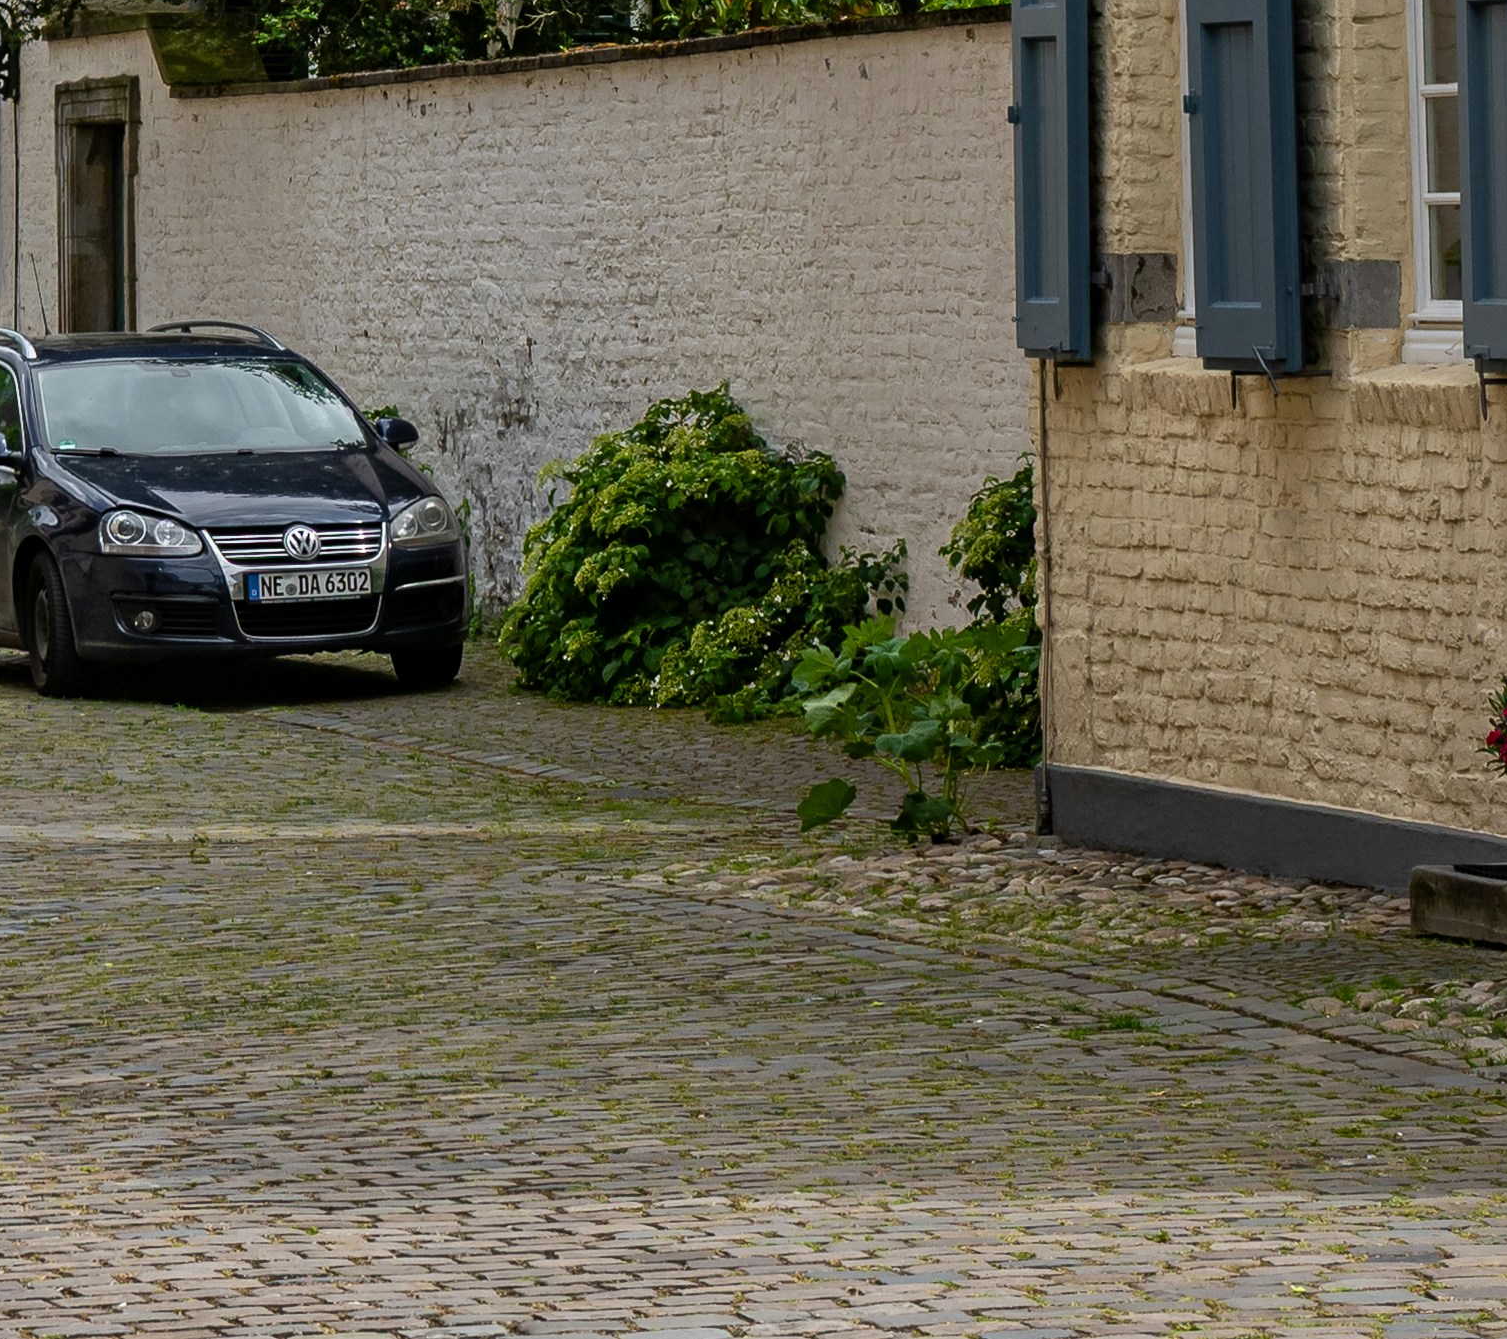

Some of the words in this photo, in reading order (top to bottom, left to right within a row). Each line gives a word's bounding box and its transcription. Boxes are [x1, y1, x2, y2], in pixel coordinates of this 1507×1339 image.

[261, 576, 284, 597] NE
[298, 573, 321, 595] DA
[325, 571, 369, 593] 6302
